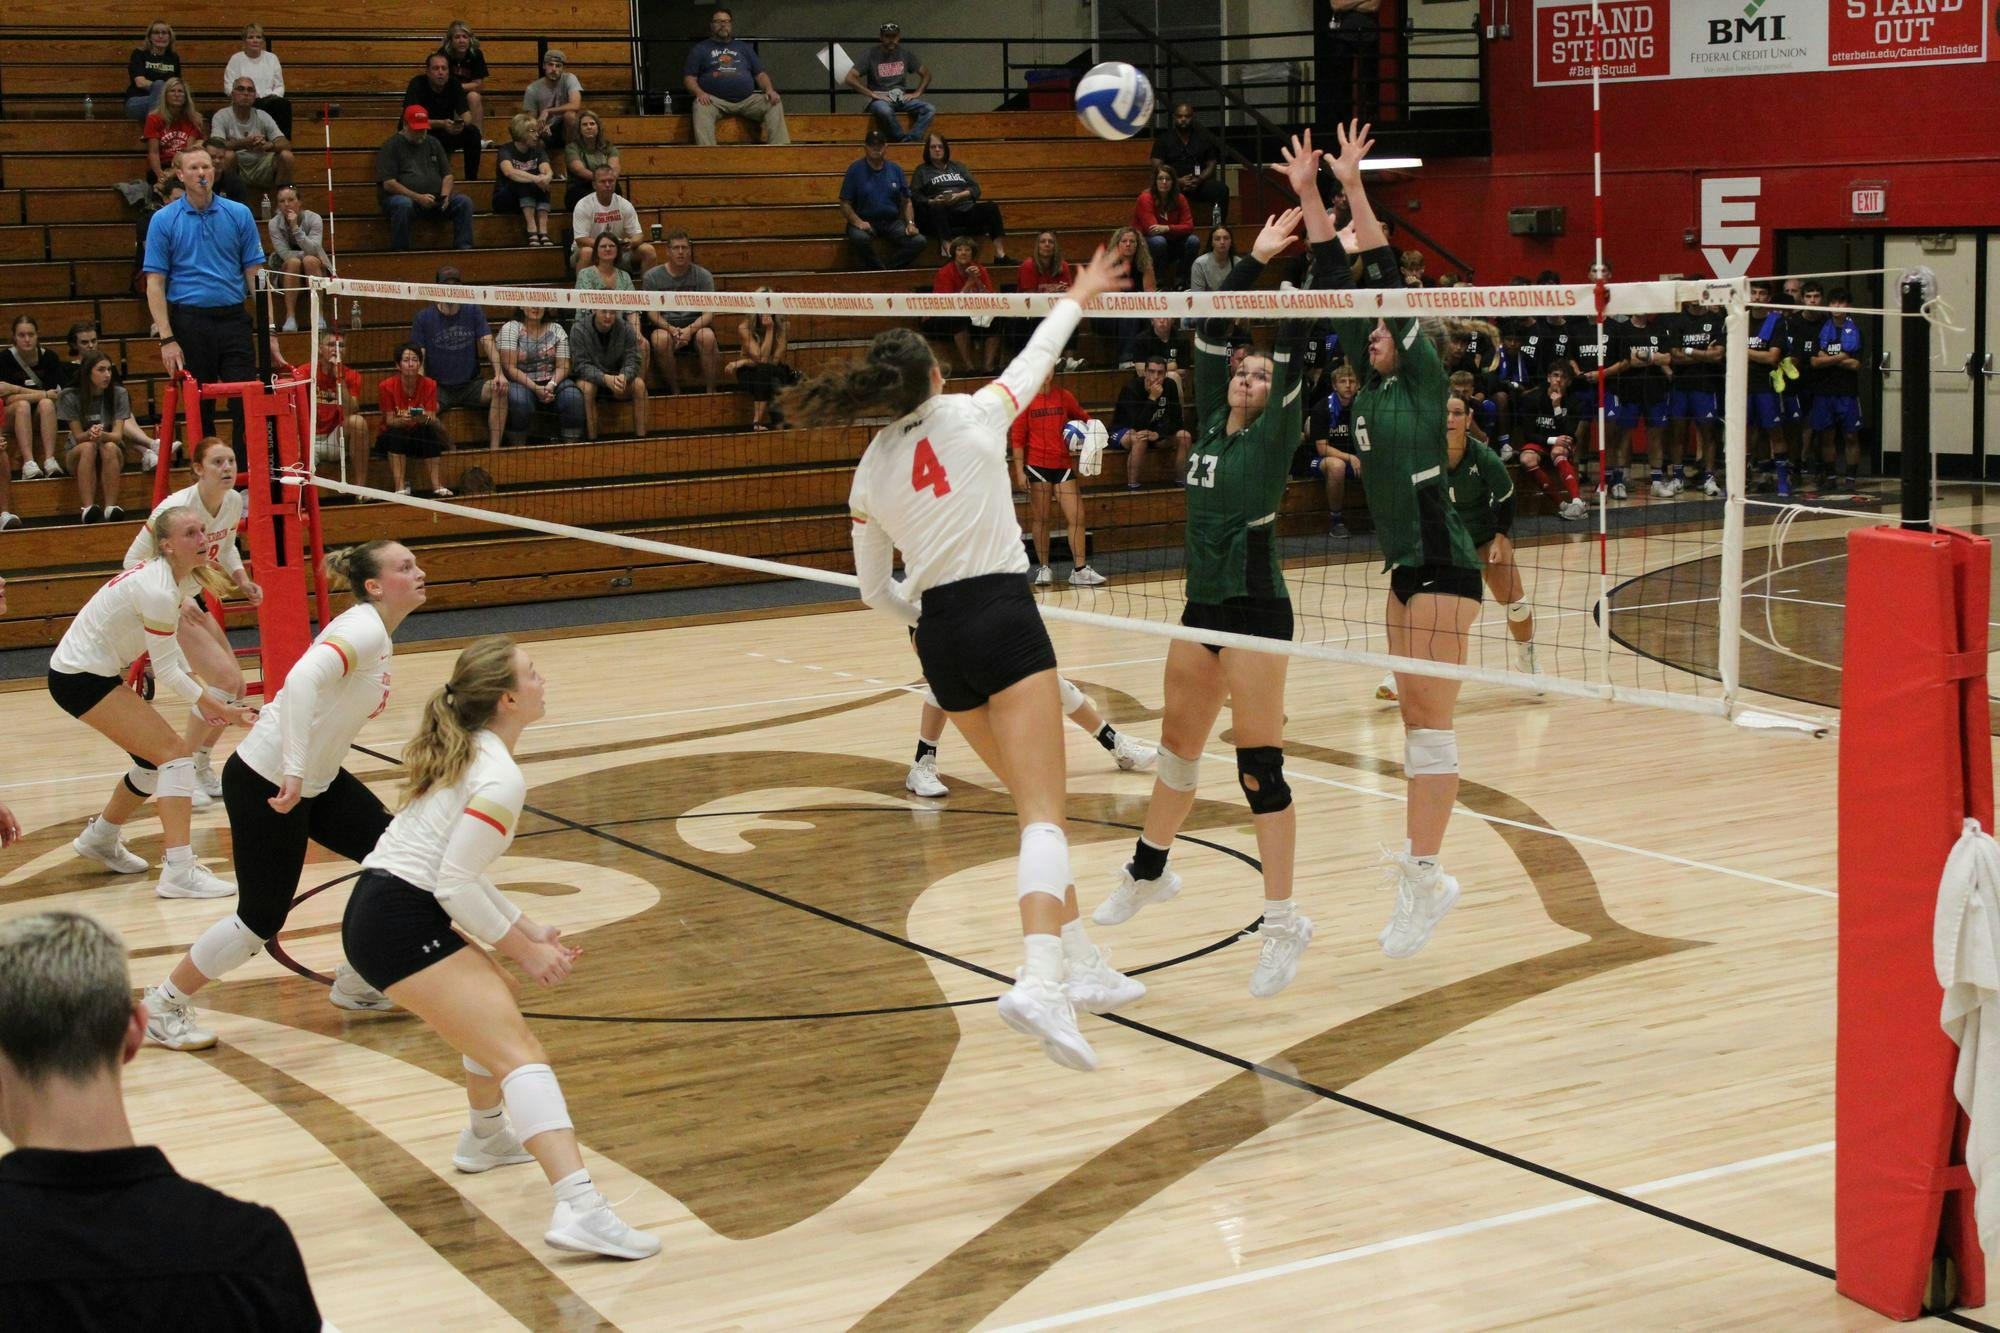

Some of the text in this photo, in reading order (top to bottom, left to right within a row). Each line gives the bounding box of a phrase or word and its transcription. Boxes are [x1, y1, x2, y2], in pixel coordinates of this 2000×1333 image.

[1552, 5, 1654, 38] STAND
[1707, 15, 1787, 45] BMI
[1874, 17, 1935, 45] OUT
[1552, 36, 1654, 64] STRONG
[1690, 47, 1807, 63] FEDERAL CREDIT UNION
[1831, 44, 1979, 62] otterbein.edu/CardinalInsider
[1857, 191, 1879, 211] EXIT
[418, 286, 475, 299] OTTERBEIN CARDINALS
[495, 290, 558, 303] OTTERBEIN CARDINALS
[579, 293, 651, 306] OTTERBEIN CARDINALS
[674, 295, 756, 308] OTTERBEIN CARDINALS
[1212, 293, 1354, 310] OTTERBEIN CARDINALS
[1406, 290, 1576, 308] OTTERBEIN CARDINALS
[782, 297, 874, 310] OTTERBEIN CARDINALS
[905, 297, 1010, 310] OTTERBEIN CARDINALS
[1106, 296, 1168, 310] CARDINALS
[1354, 415, 1371, 451] 6
[911, 436, 952, 499] 4
[1185, 453, 1218, 489] 23
